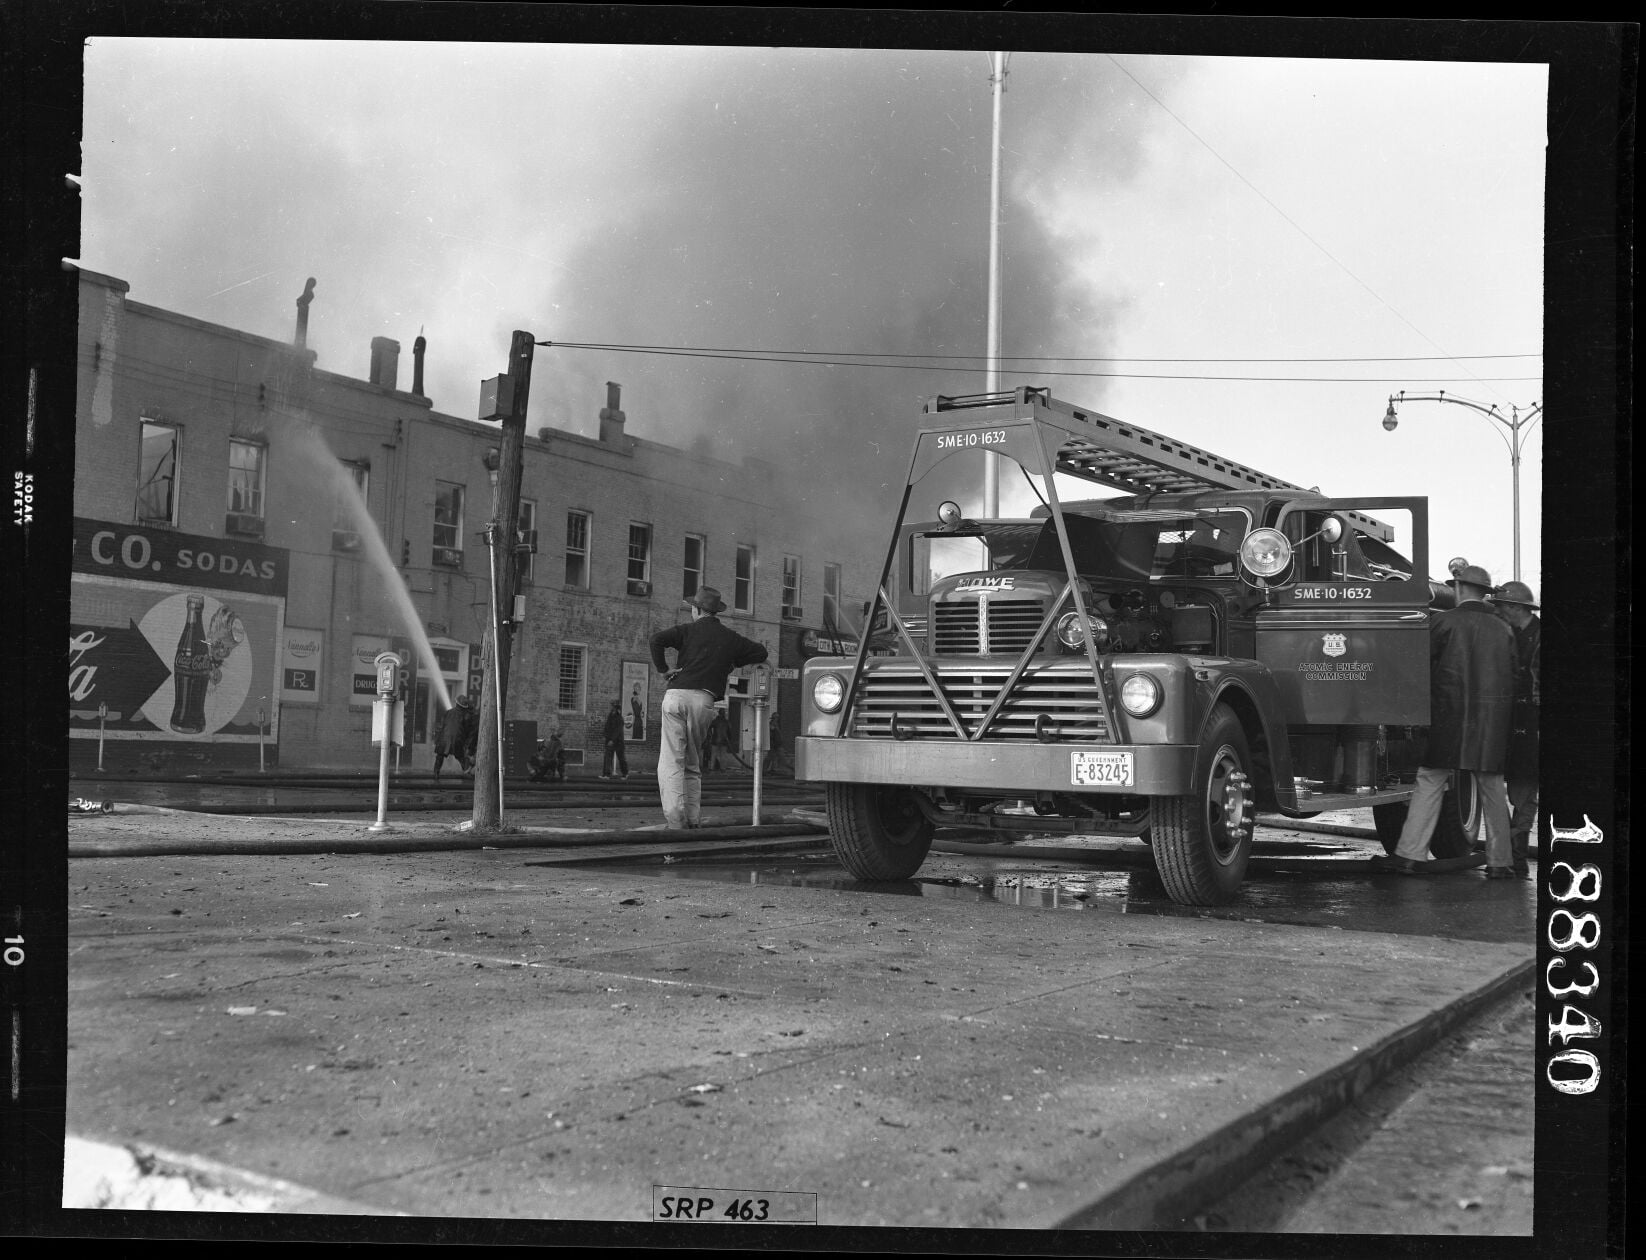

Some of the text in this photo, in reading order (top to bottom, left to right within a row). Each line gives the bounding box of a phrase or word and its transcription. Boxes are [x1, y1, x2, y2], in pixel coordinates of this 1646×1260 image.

[91, 531, 162, 571] CO.
[176, 549, 276, 580] SODAS
[957, 577, 1015, 589] HOWE
[1298, 663, 1375, 672] ATOMIC ENERGY
[1306, 672, 1367, 681] COMMISSION
[355, 679, 378, 689] DRUG
[1075, 763, 1129, 782] E-83245
